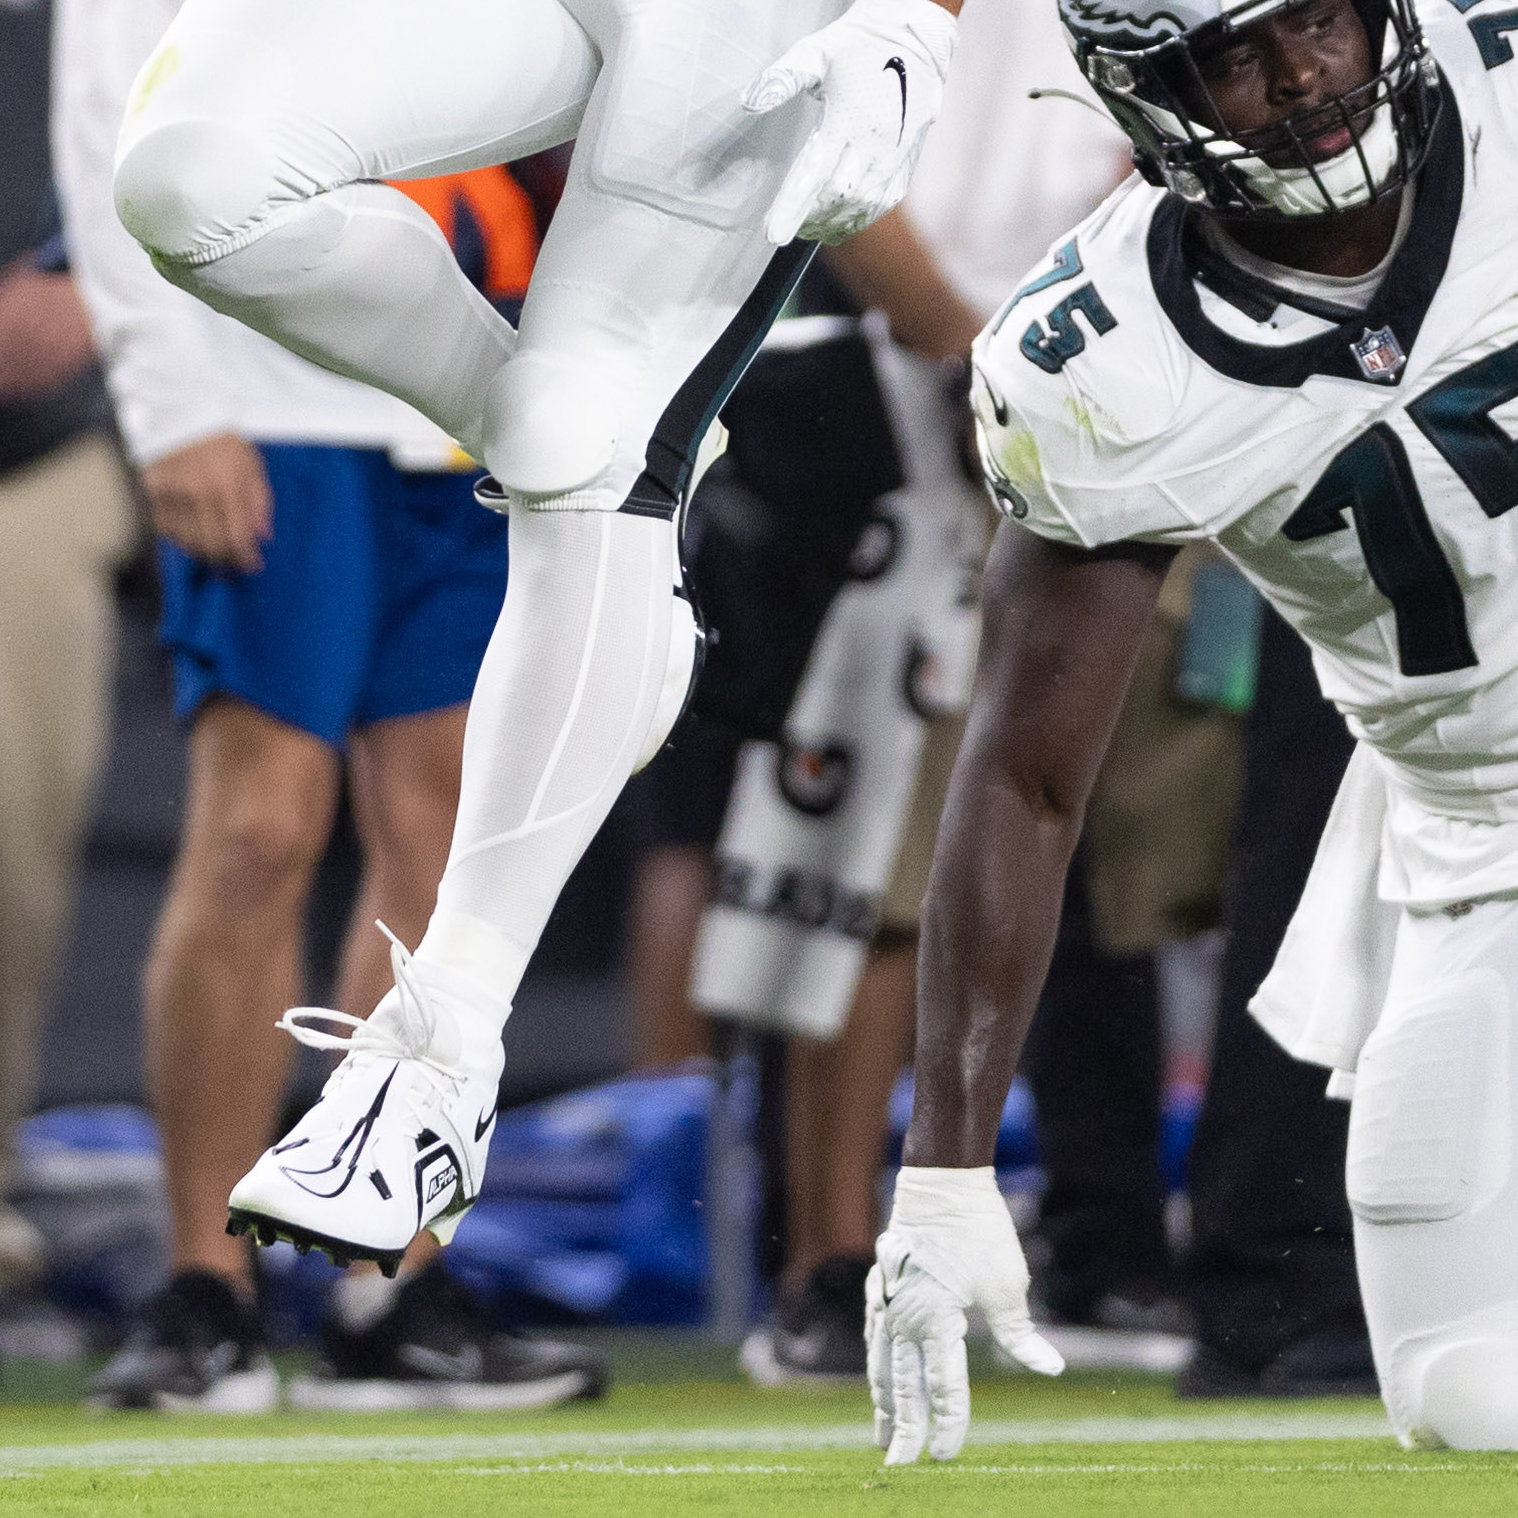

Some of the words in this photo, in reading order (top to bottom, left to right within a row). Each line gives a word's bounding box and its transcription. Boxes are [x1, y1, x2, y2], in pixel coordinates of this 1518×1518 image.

[993, 234, 1119, 375] 75
[1366, 345, 1397, 372] NFL
[425, 1164, 459, 1204] ALPHA
